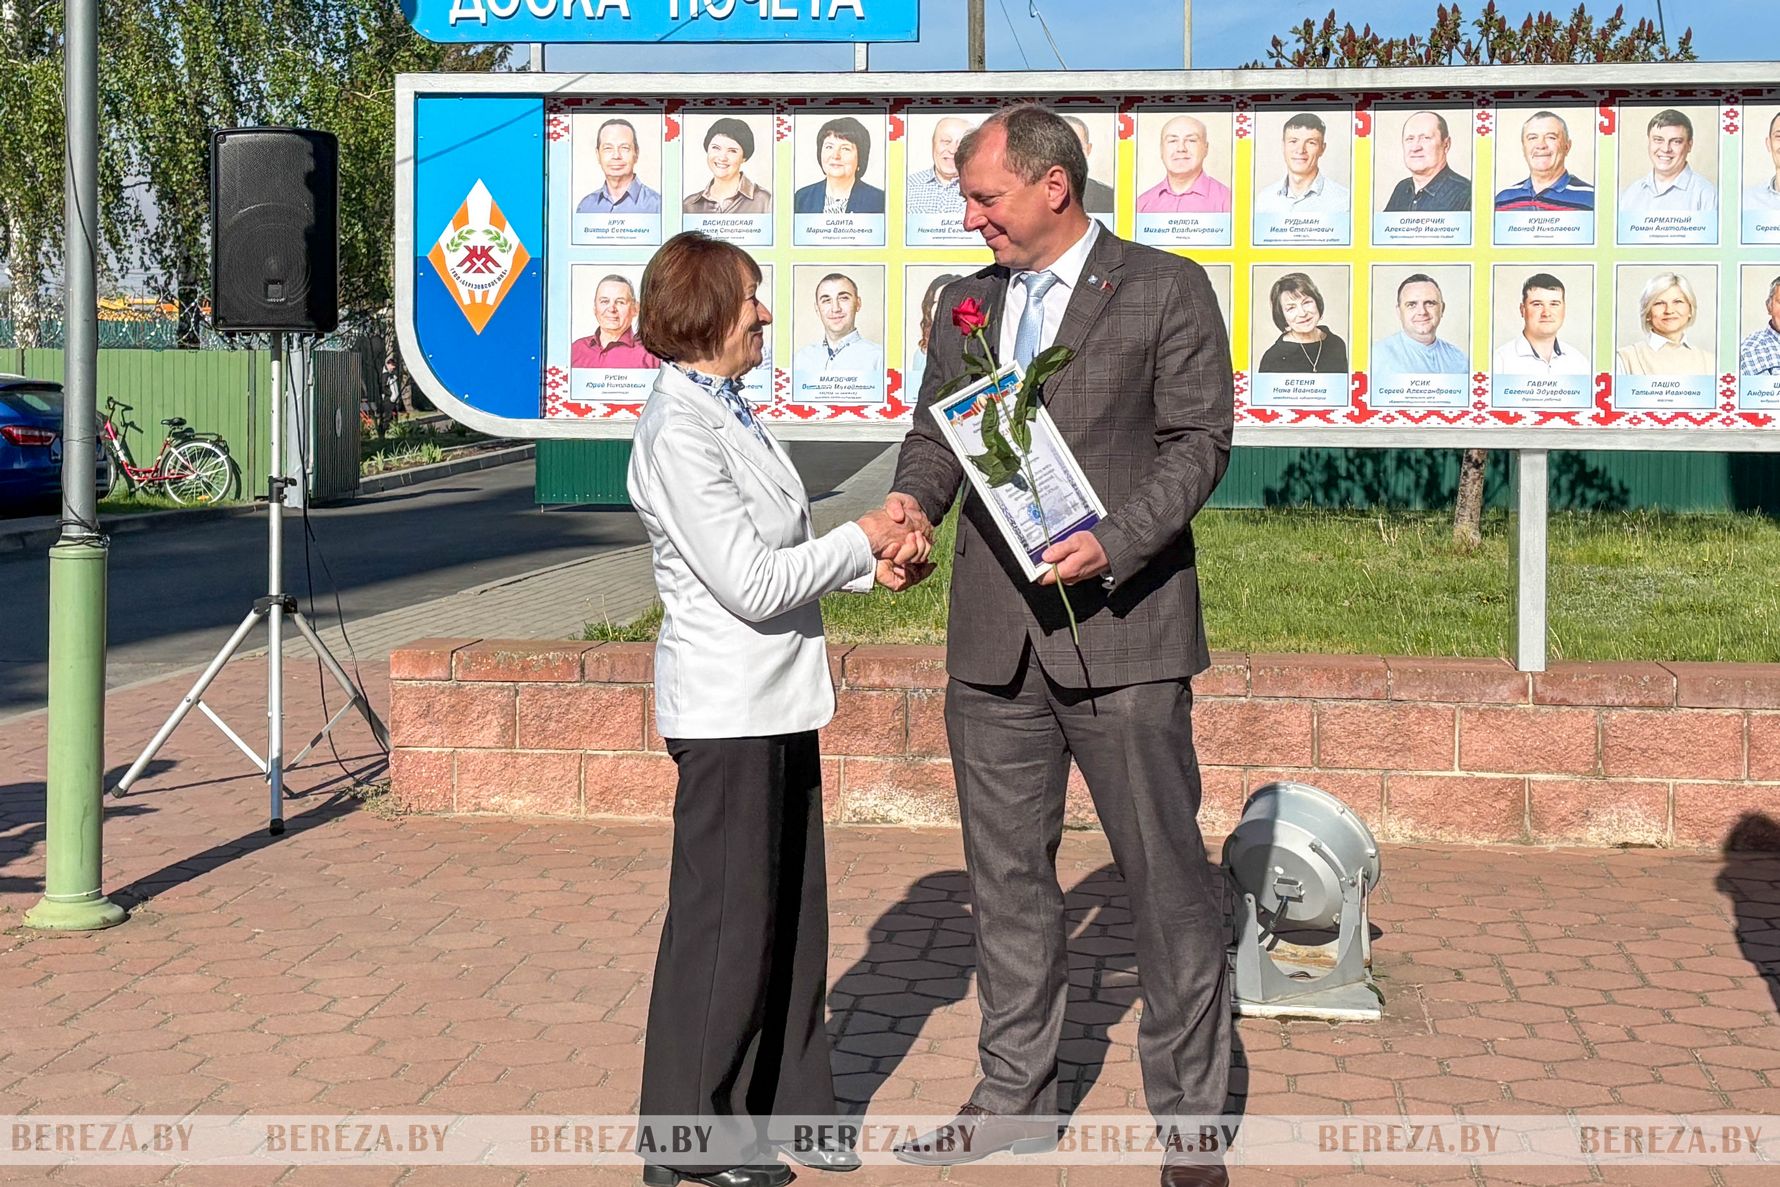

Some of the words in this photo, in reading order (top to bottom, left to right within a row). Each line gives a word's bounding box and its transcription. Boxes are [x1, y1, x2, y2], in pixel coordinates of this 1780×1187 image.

[1644, 215, 1692, 224] ГАРМАТНЫЙ
[1631, 388, 1664, 396] Татьяна
[1747, 389, 1775, 397] Андрей
